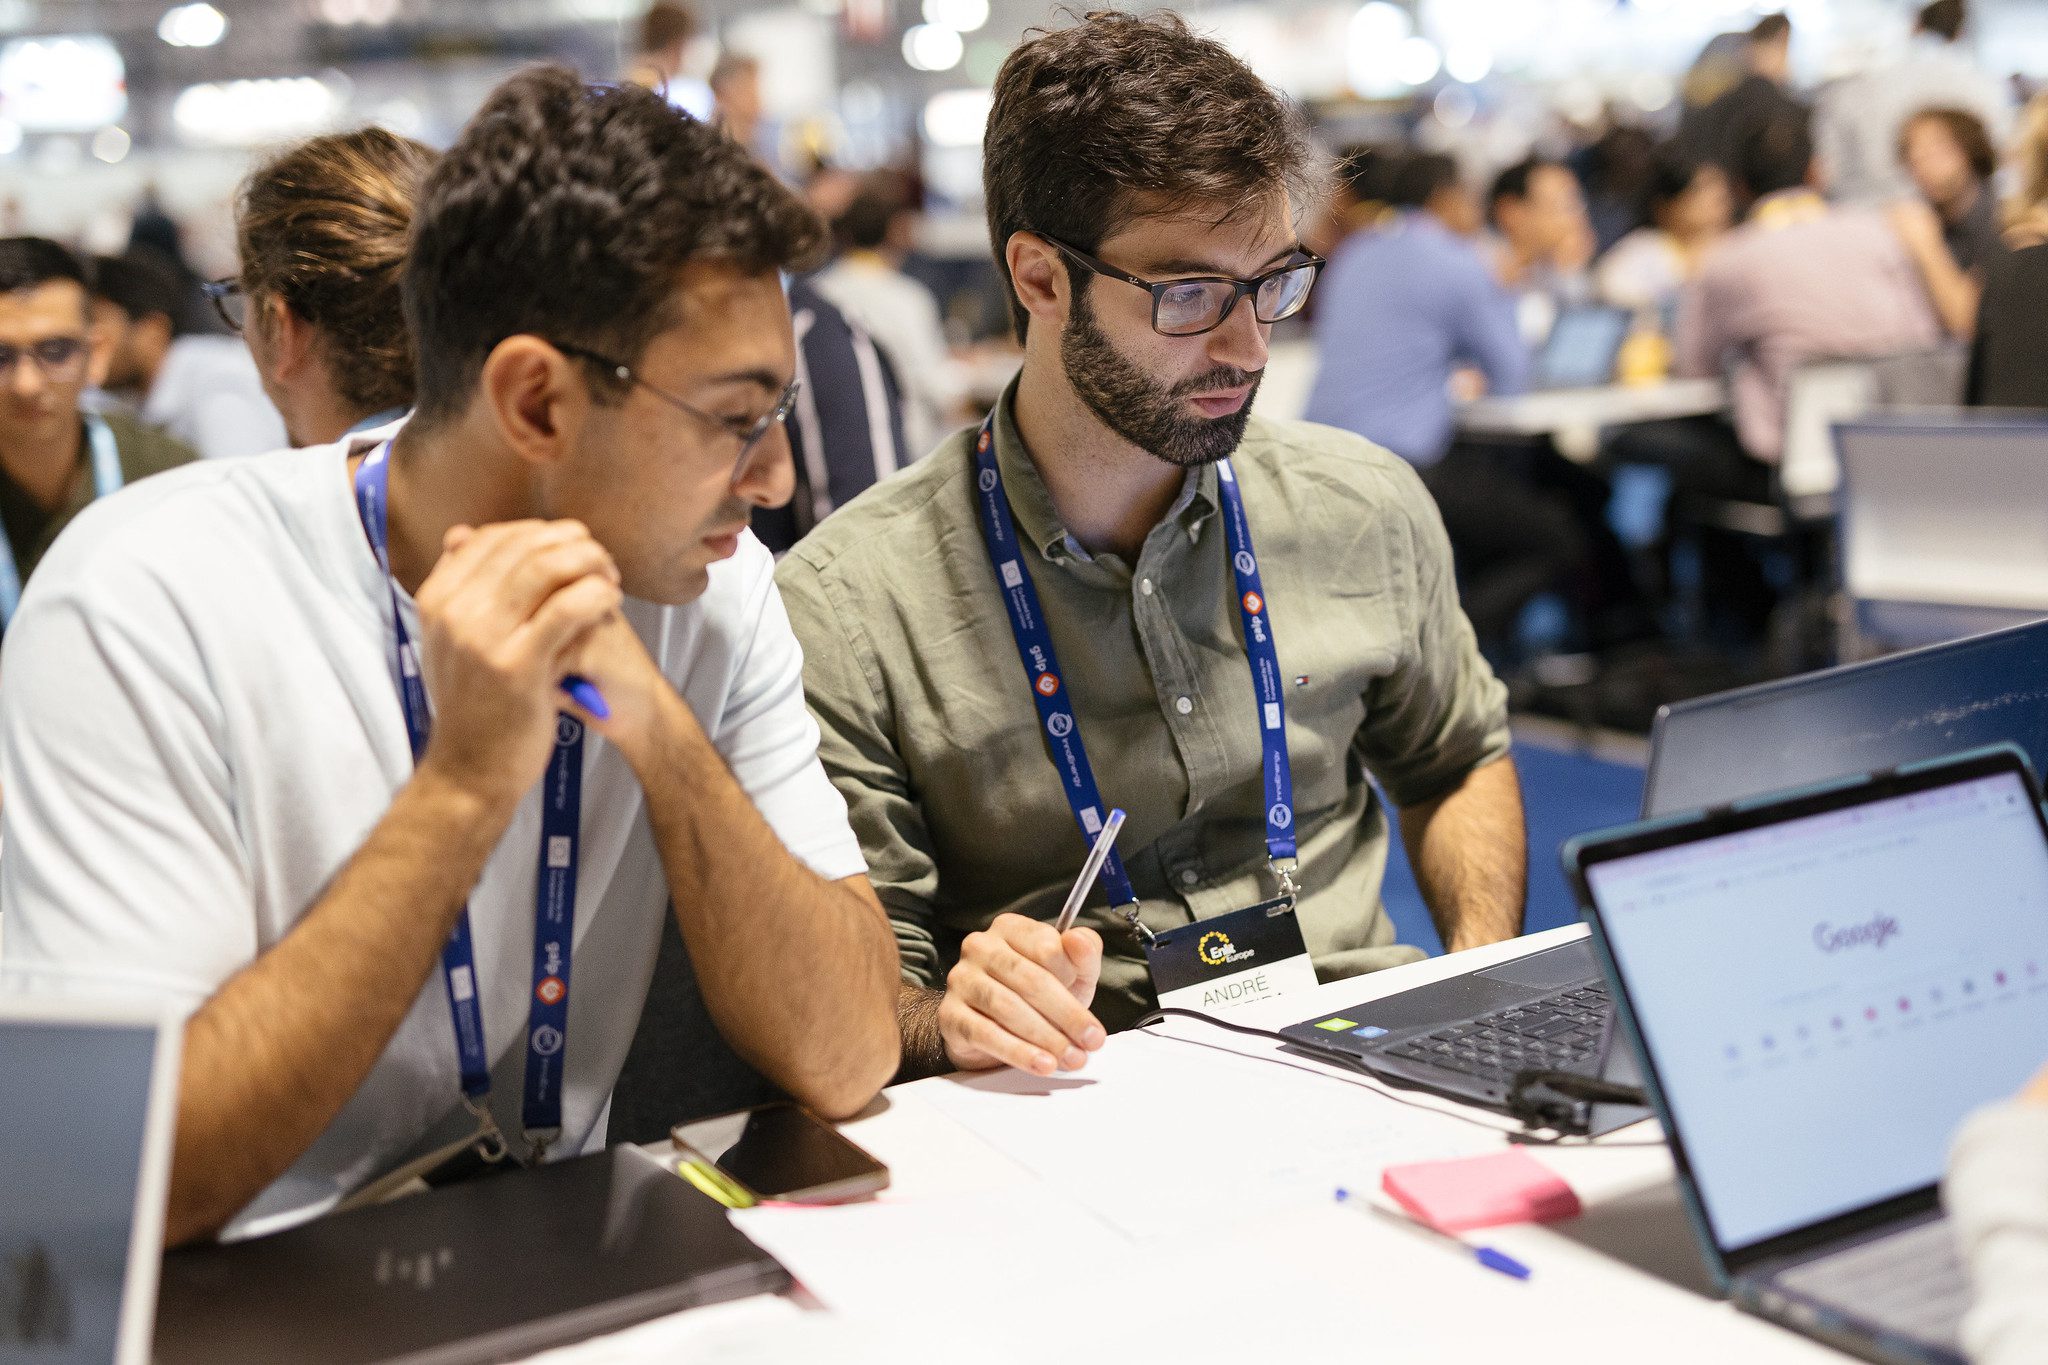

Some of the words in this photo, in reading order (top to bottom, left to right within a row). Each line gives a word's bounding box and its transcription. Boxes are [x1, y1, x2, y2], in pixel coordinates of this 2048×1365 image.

[1251, 616, 1267, 643] galp
[1029, 645, 1048, 672] galp
[1062, 738, 1082, 788] InnoEnergy
[1273, 750, 1282, 802] InnoEnergy
[1811, 911, 1900, 954] Google
[544, 940, 562, 976] galp
[1225, 948, 1256, 963] Europe
[1203, 971, 1270, 1007] ANDRÉ
